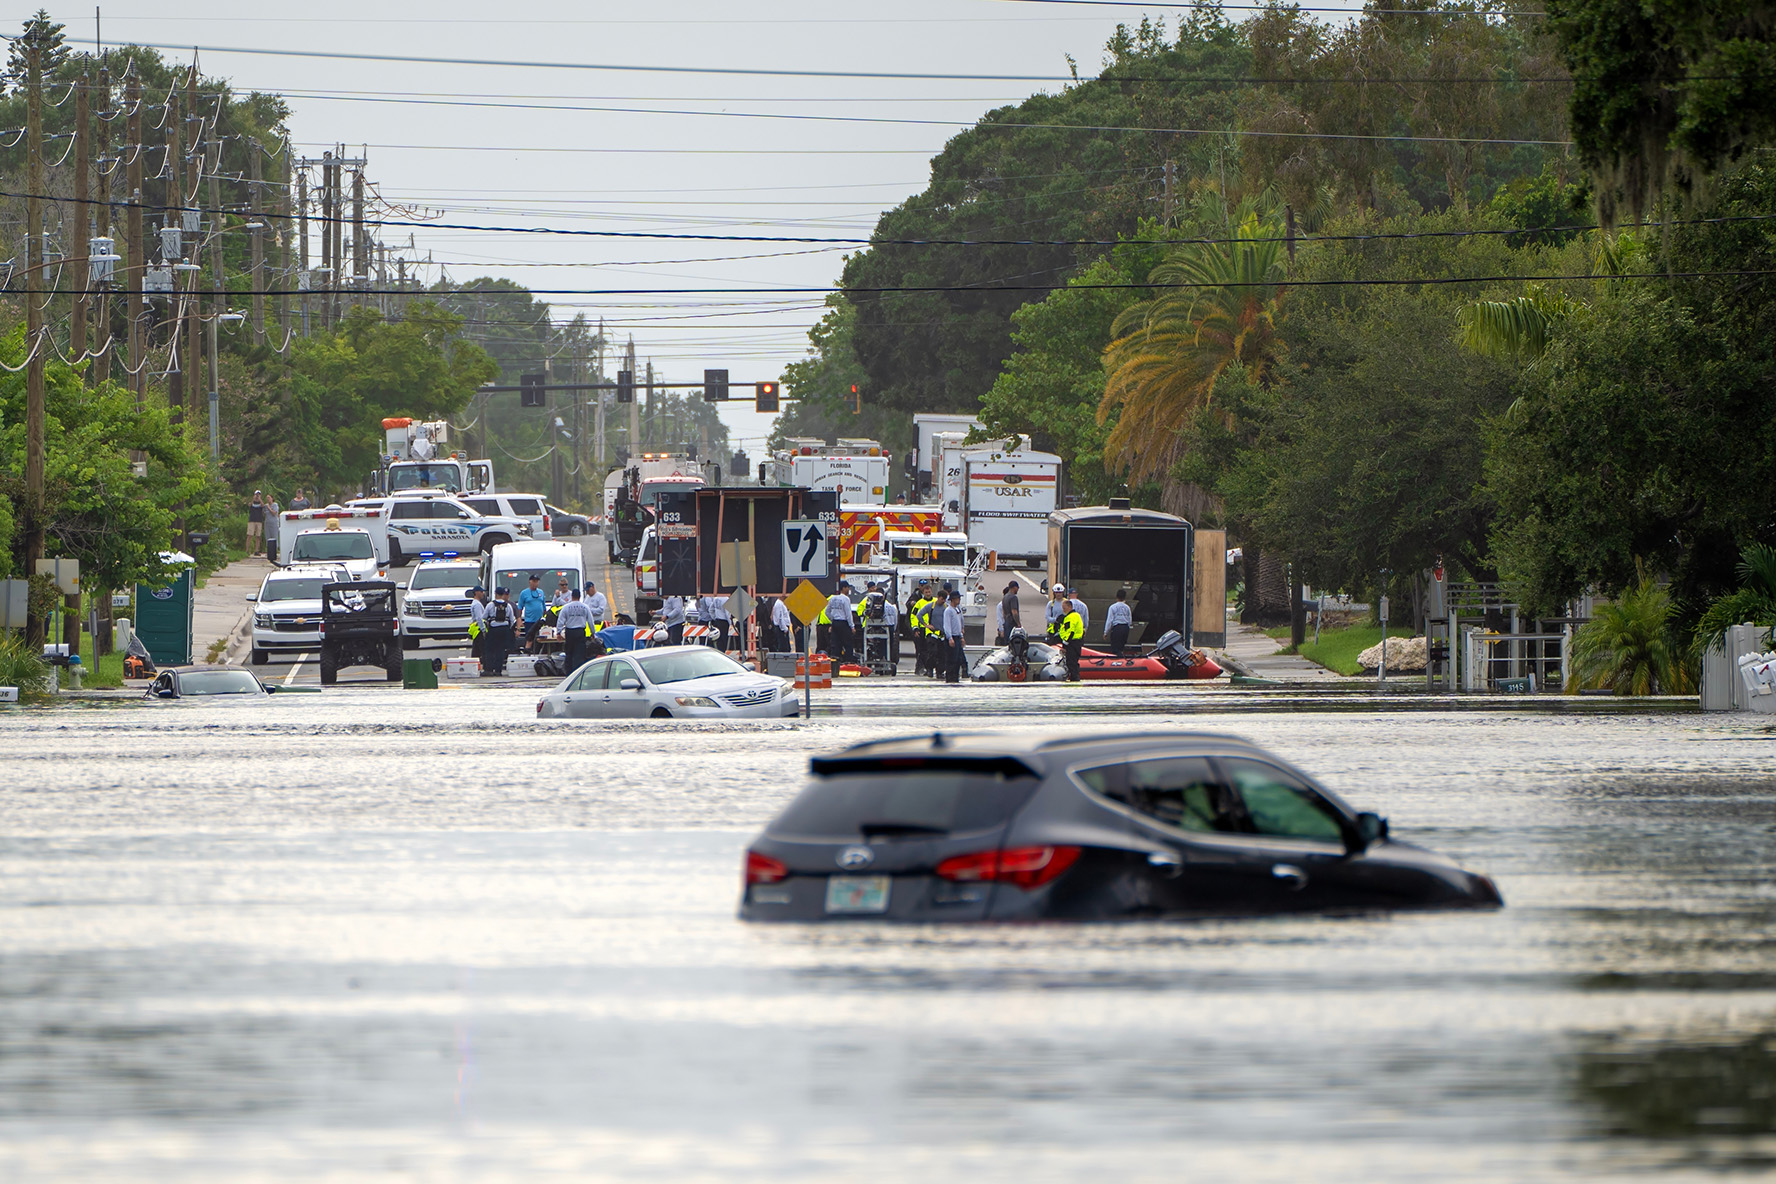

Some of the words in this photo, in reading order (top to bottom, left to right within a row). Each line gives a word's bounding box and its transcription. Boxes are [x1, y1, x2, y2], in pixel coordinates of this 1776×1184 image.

[947, 468, 960, 476] 26
[994, 487, 1032, 497] USAR
[663, 512, 680, 522] 633
[819, 512, 835, 521] 633
